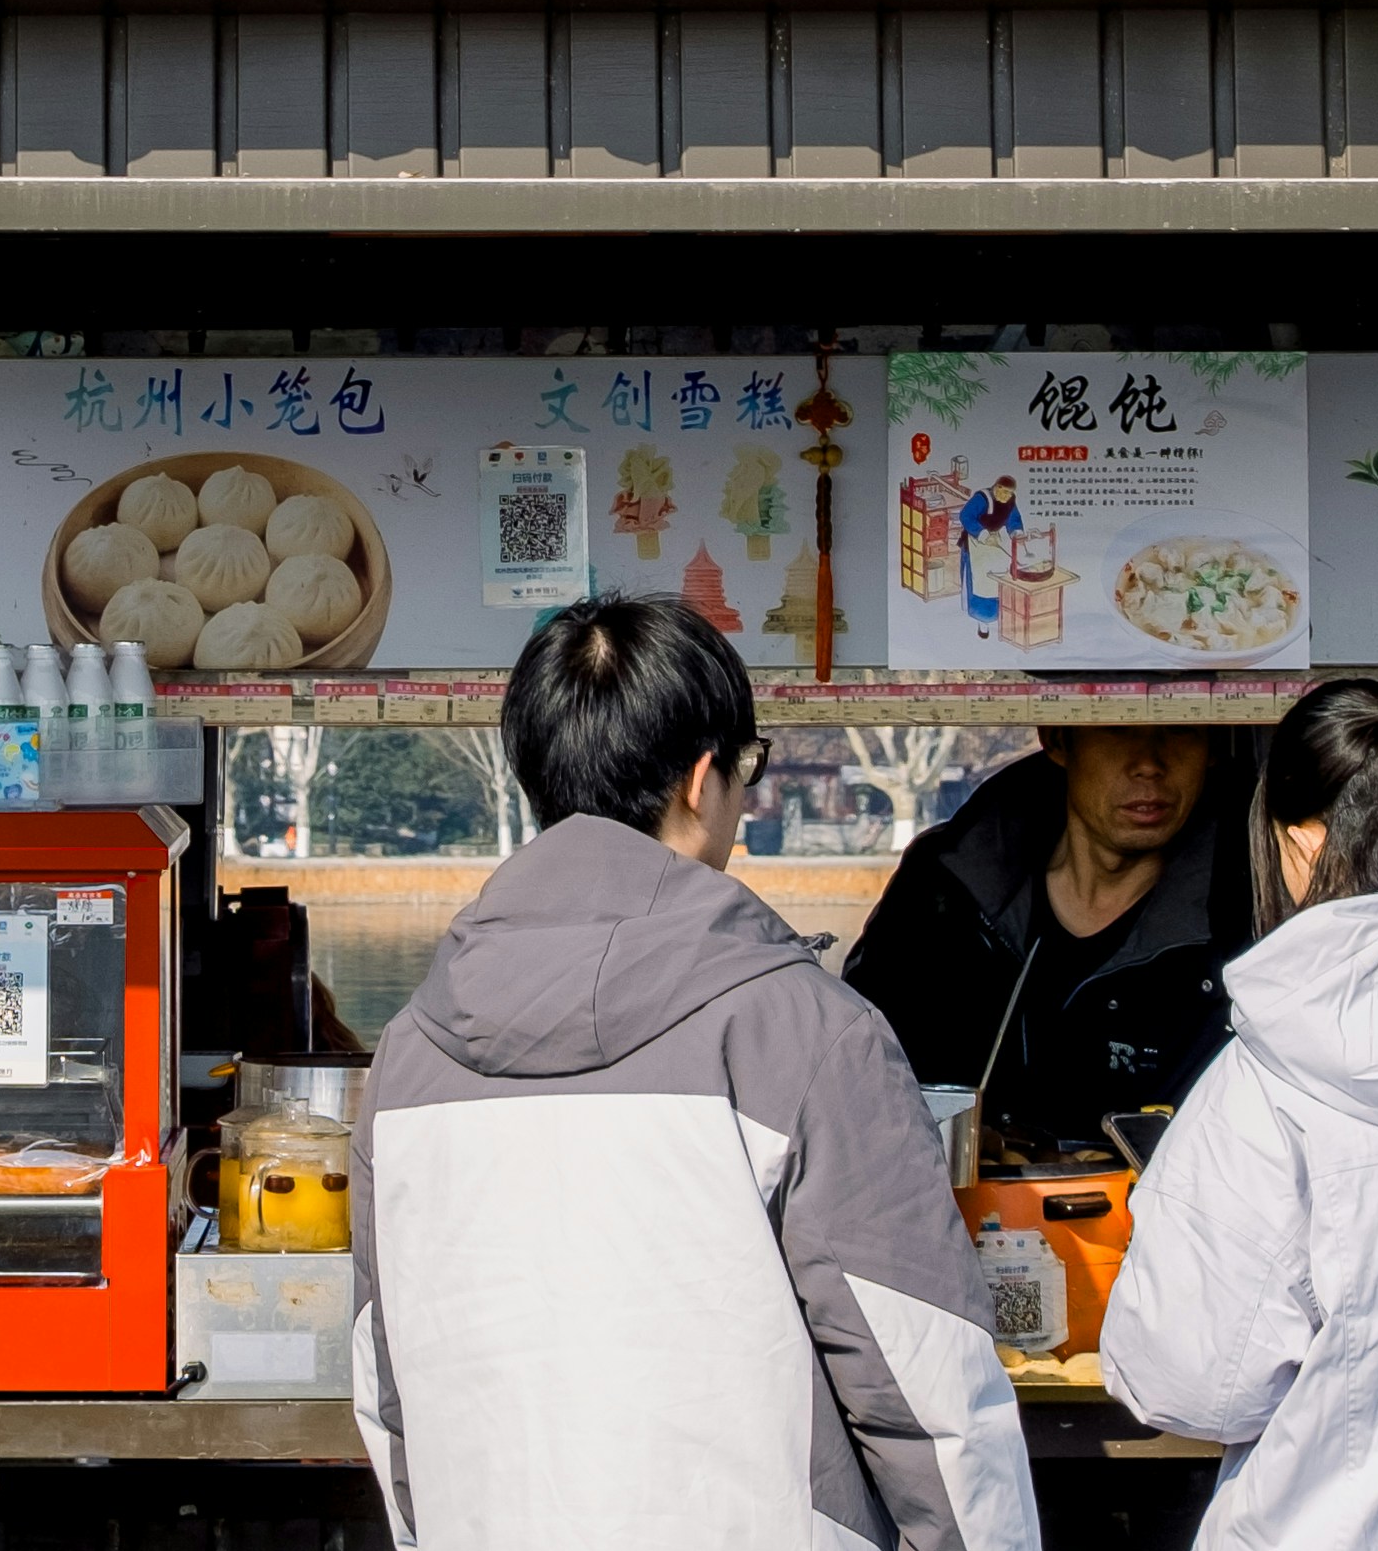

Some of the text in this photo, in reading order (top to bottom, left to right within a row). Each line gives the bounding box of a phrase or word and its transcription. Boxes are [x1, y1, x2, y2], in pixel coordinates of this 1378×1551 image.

[63, 366, 385, 437] 杭州小笼包
[534, 367, 792, 433] 文创雪糕
[1028, 370, 1177, 434] 馄饨
[512, 472, 553, 484] 扫码付款
